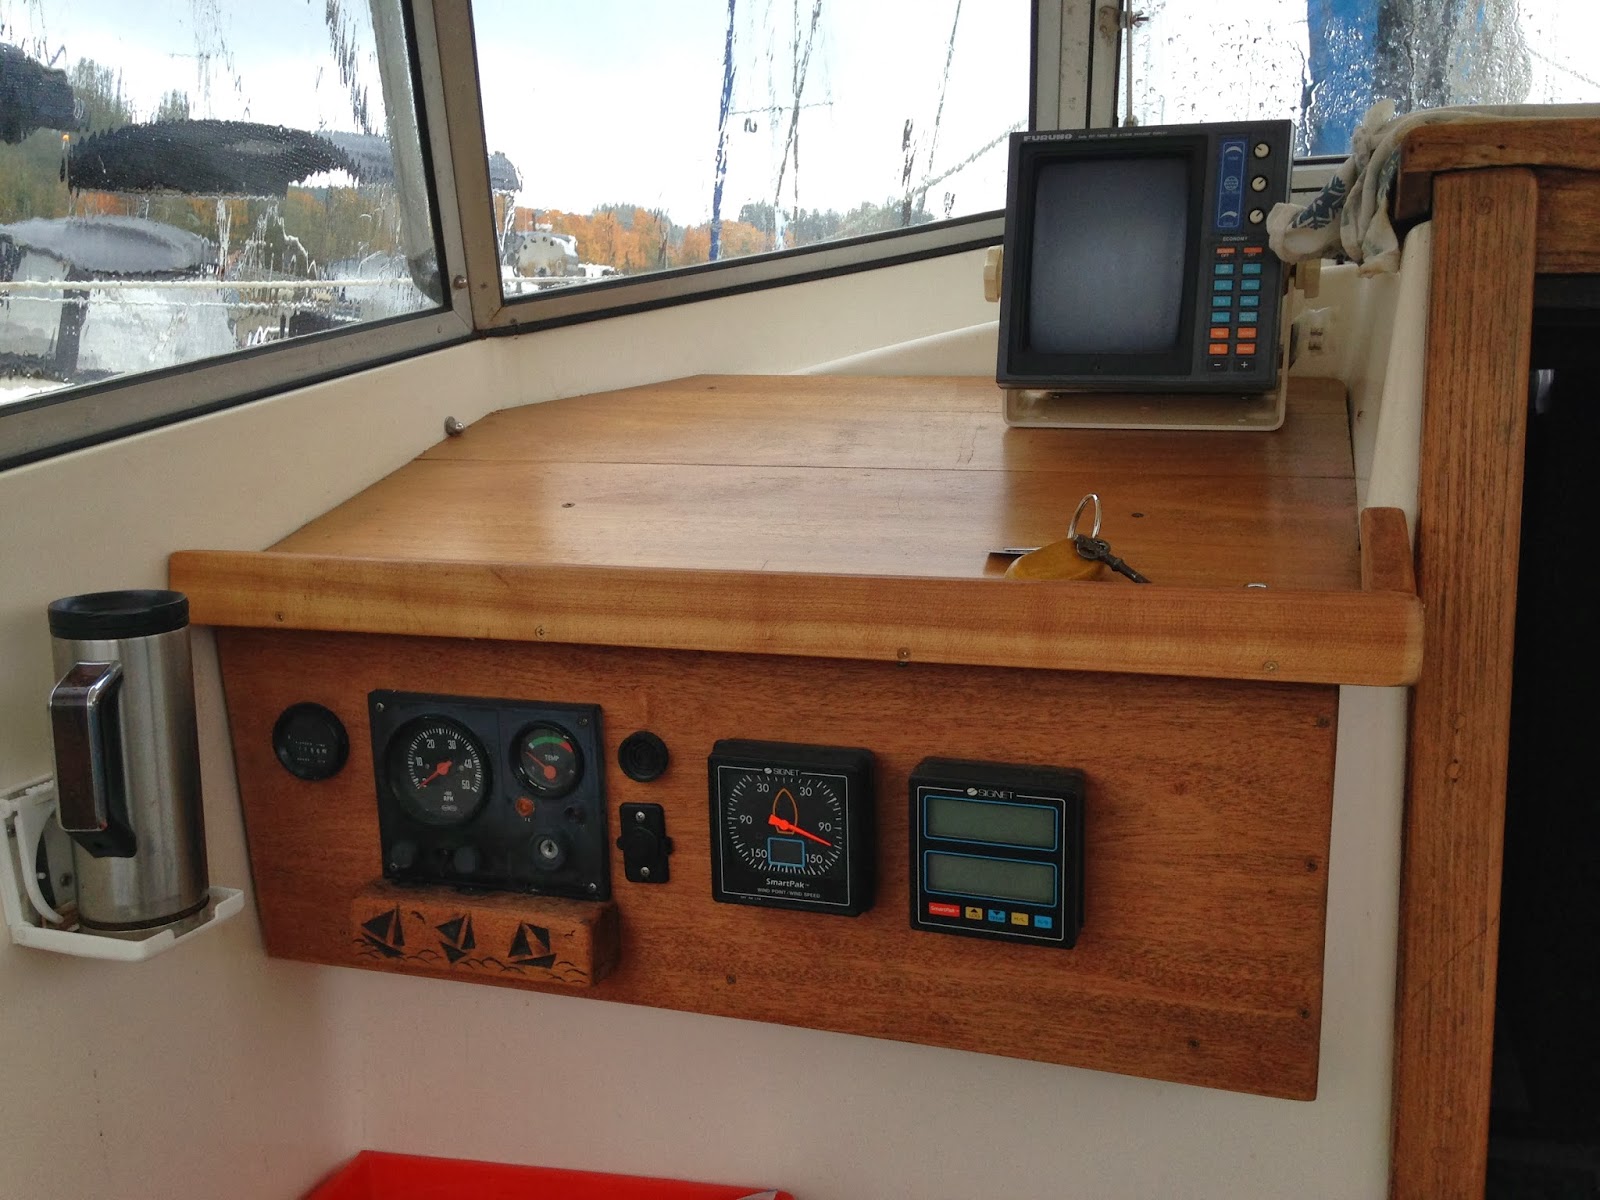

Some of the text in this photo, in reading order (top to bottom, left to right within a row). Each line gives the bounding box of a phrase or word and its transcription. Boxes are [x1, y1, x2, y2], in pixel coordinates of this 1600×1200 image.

[1023, 133, 1073, 142] FURUNO
[426, 739, 435, 749] 20
[447, 739, 457, 750] 30
[415, 756, 423, 767] 10
[544, 754, 560, 762] TEMP
[464, 759, 473, 769] 40
[773, 768, 800, 777] SIGNET
[461, 780, 470, 790] 50
[756, 783, 770, 793] 30
[799, 786, 813, 797] 30
[977, 788, 1014, 800] SIGNET
[739, 814, 753, 825] 90
[818, 821, 832, 832] 90
[750, 847, 768, 859] 150
[805, 853, 823, 864] 150
[803, 891, 821, 899] SPEED
